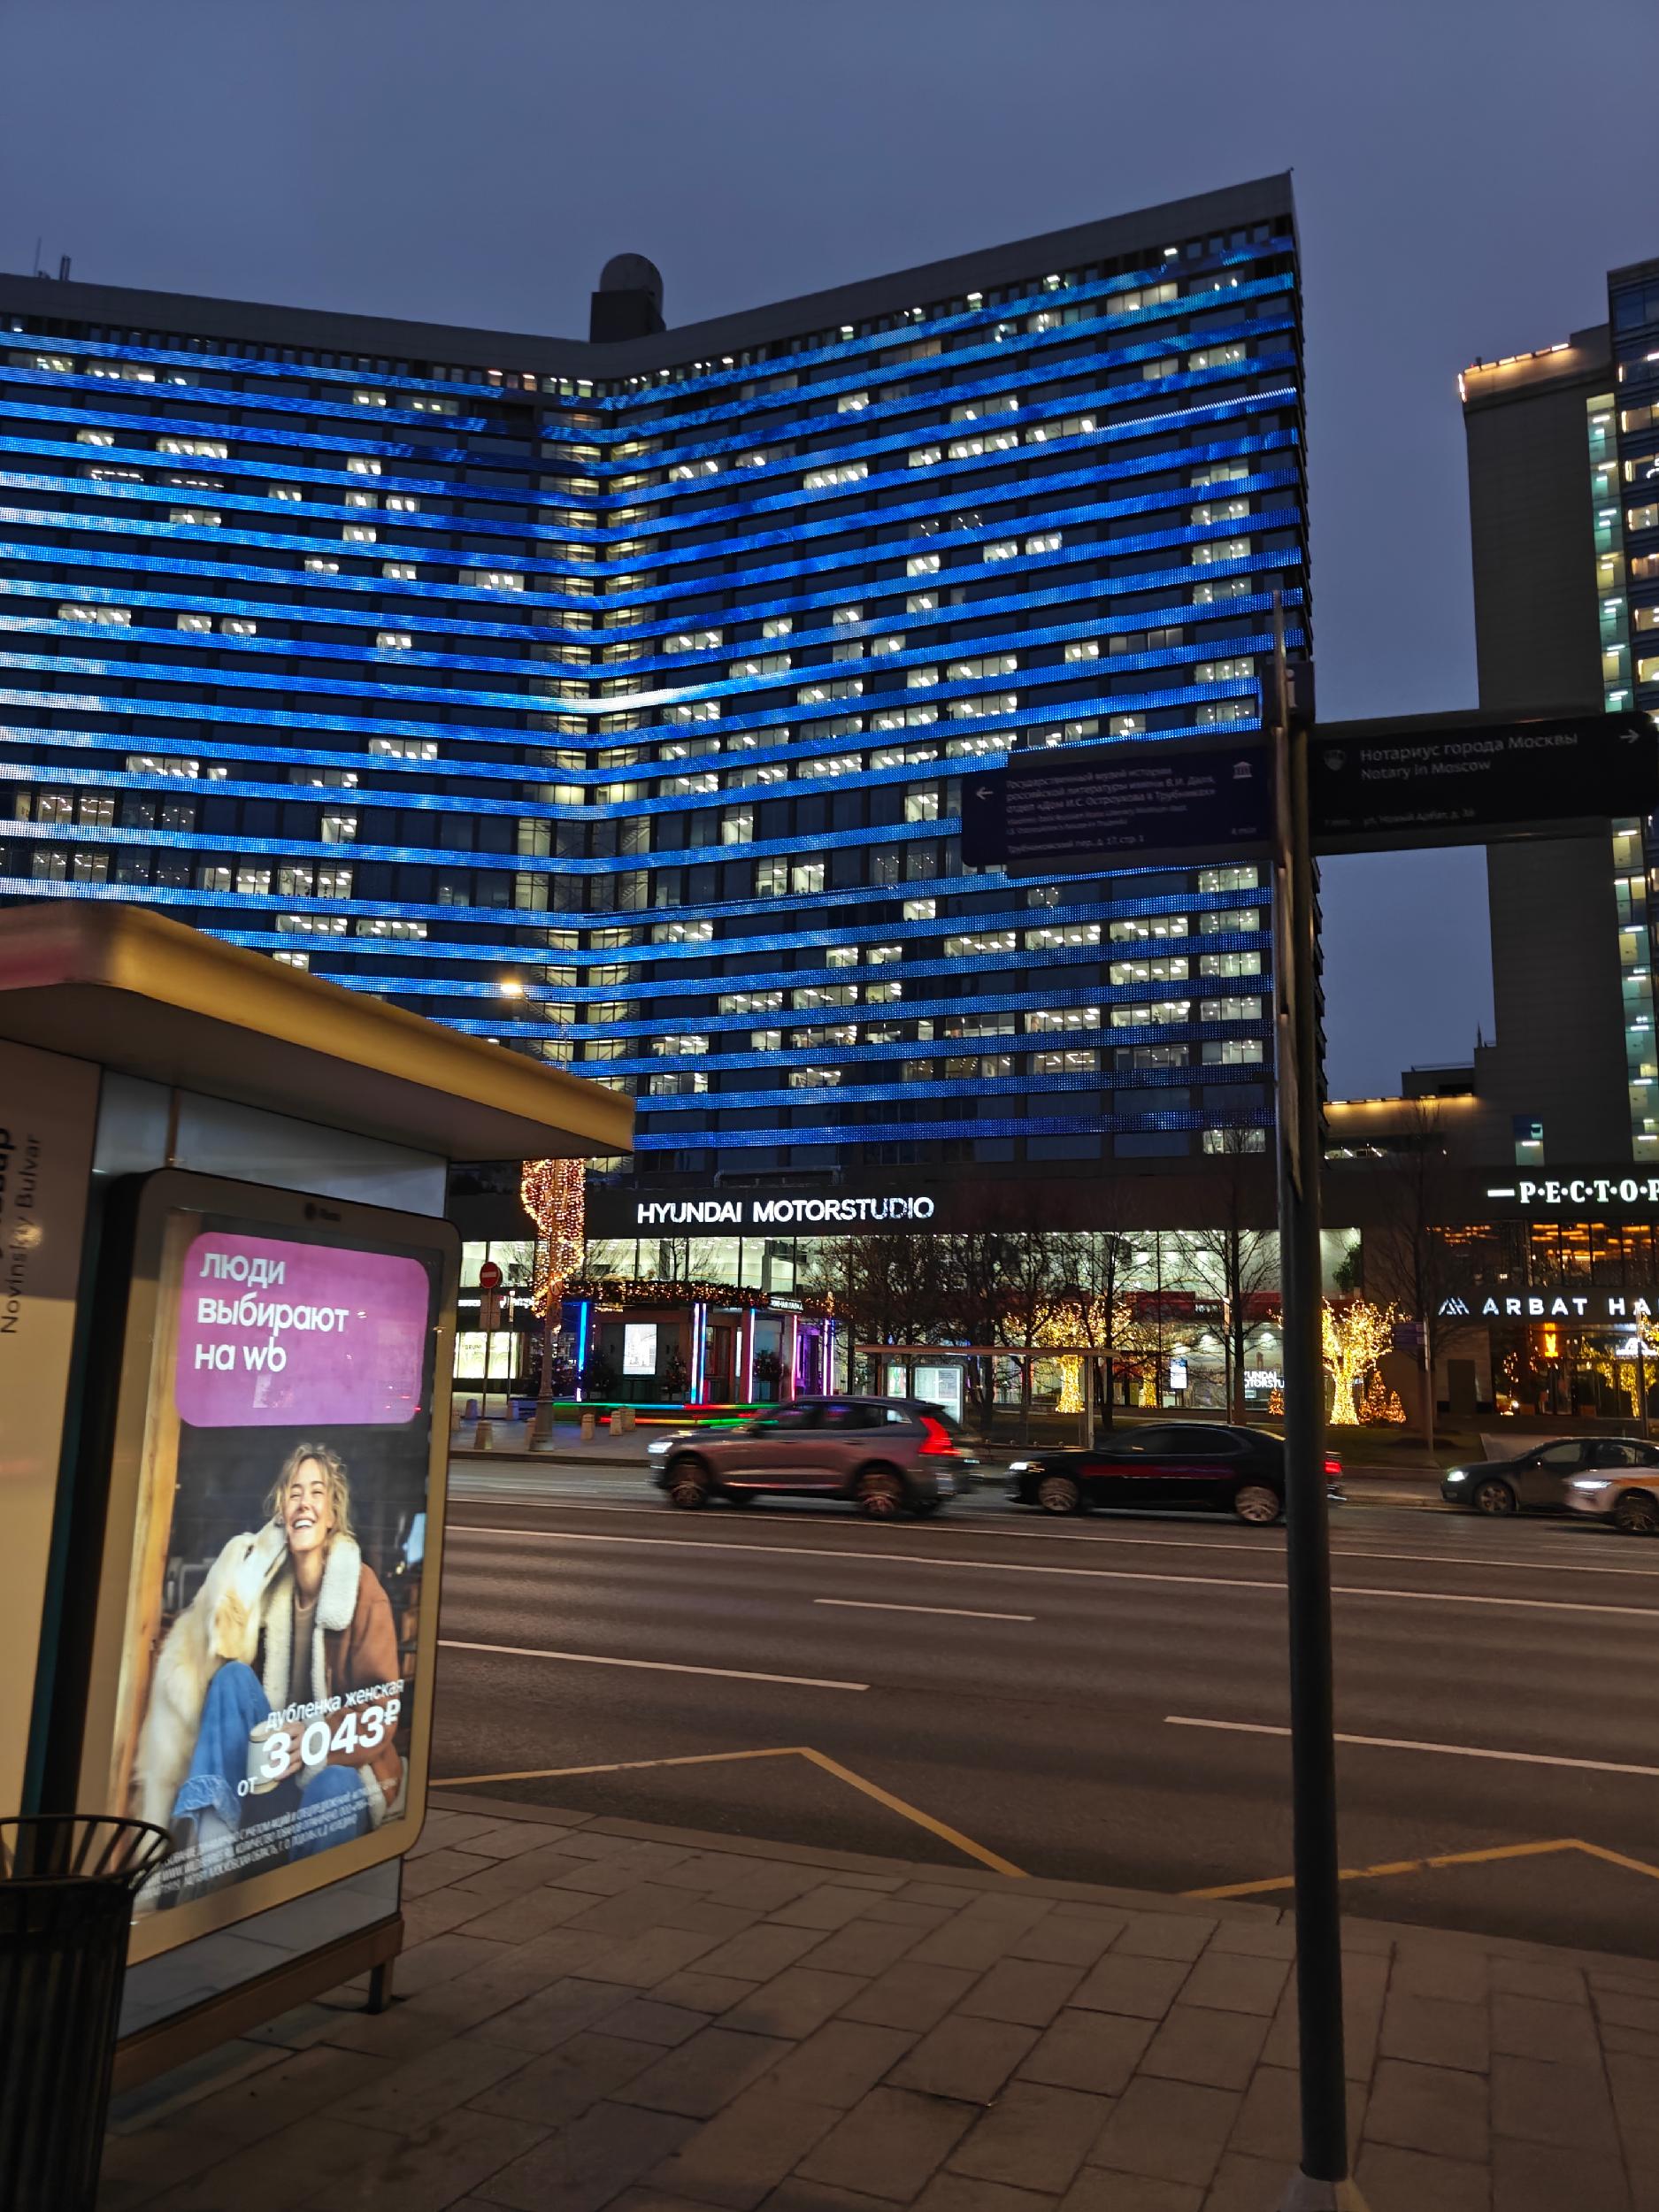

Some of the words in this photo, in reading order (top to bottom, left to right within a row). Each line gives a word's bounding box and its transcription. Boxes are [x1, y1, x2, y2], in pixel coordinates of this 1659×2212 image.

[1361, 744, 1440, 762] Нотариус
[1444, 739, 1503, 757] города
[1508, 733, 1578, 749] Москвы
[1362, 764, 1410, 780] Notary
[1415, 763, 1428, 776] in
[1432, 760, 1491, 774] Moscow
[15, 1133, 41, 1209] Bulvar
[637, 1202, 741, 1224] HYUNDAI
[753, 1196, 934, 1223] MOTORSTUDIO
[199, 1253, 286, 1289] люди
[197, 1292, 349, 1337] выбирают
[1482, 1296, 1587, 1316] ARBAT
[1609, 1296, 1659, 1316] HA
[195, 1343, 235, 1370] на
[243, 1336, 287, 1372] wb
[266, 1695, 342, 1732] дубленка
[344, 1679, 404, 1708] женская
[237, 1777, 258, 1797] от
